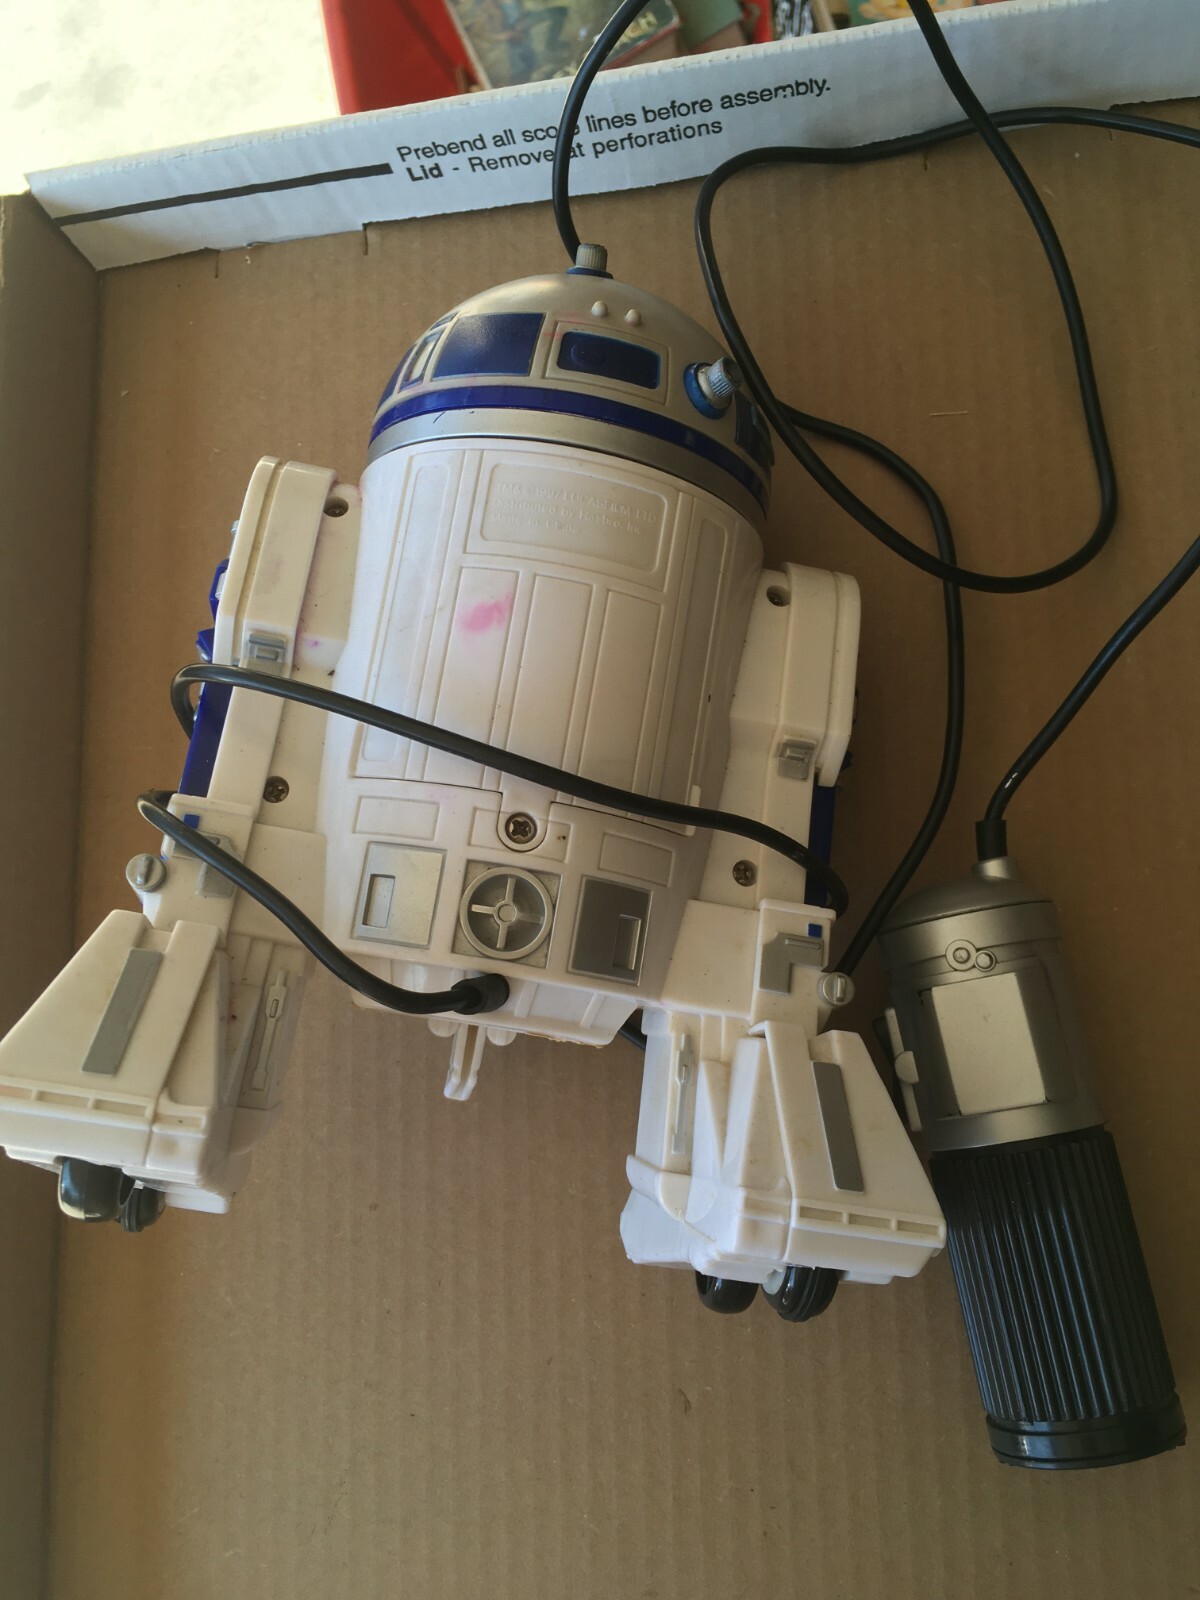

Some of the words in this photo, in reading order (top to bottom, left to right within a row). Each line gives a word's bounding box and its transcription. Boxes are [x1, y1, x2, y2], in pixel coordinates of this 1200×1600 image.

[397, 133, 487, 162] Prebend
[492, 128, 516, 147] all
[585, 112, 637, 133] lines
[641, 97, 713, 123] before
[720, 77, 831, 110] assembly.
[406, 162, 444, 182] Lid
[467, 149, 556, 173] Remove
[592, 120, 723, 159] perforations
[561, 507, 576, 520] by
